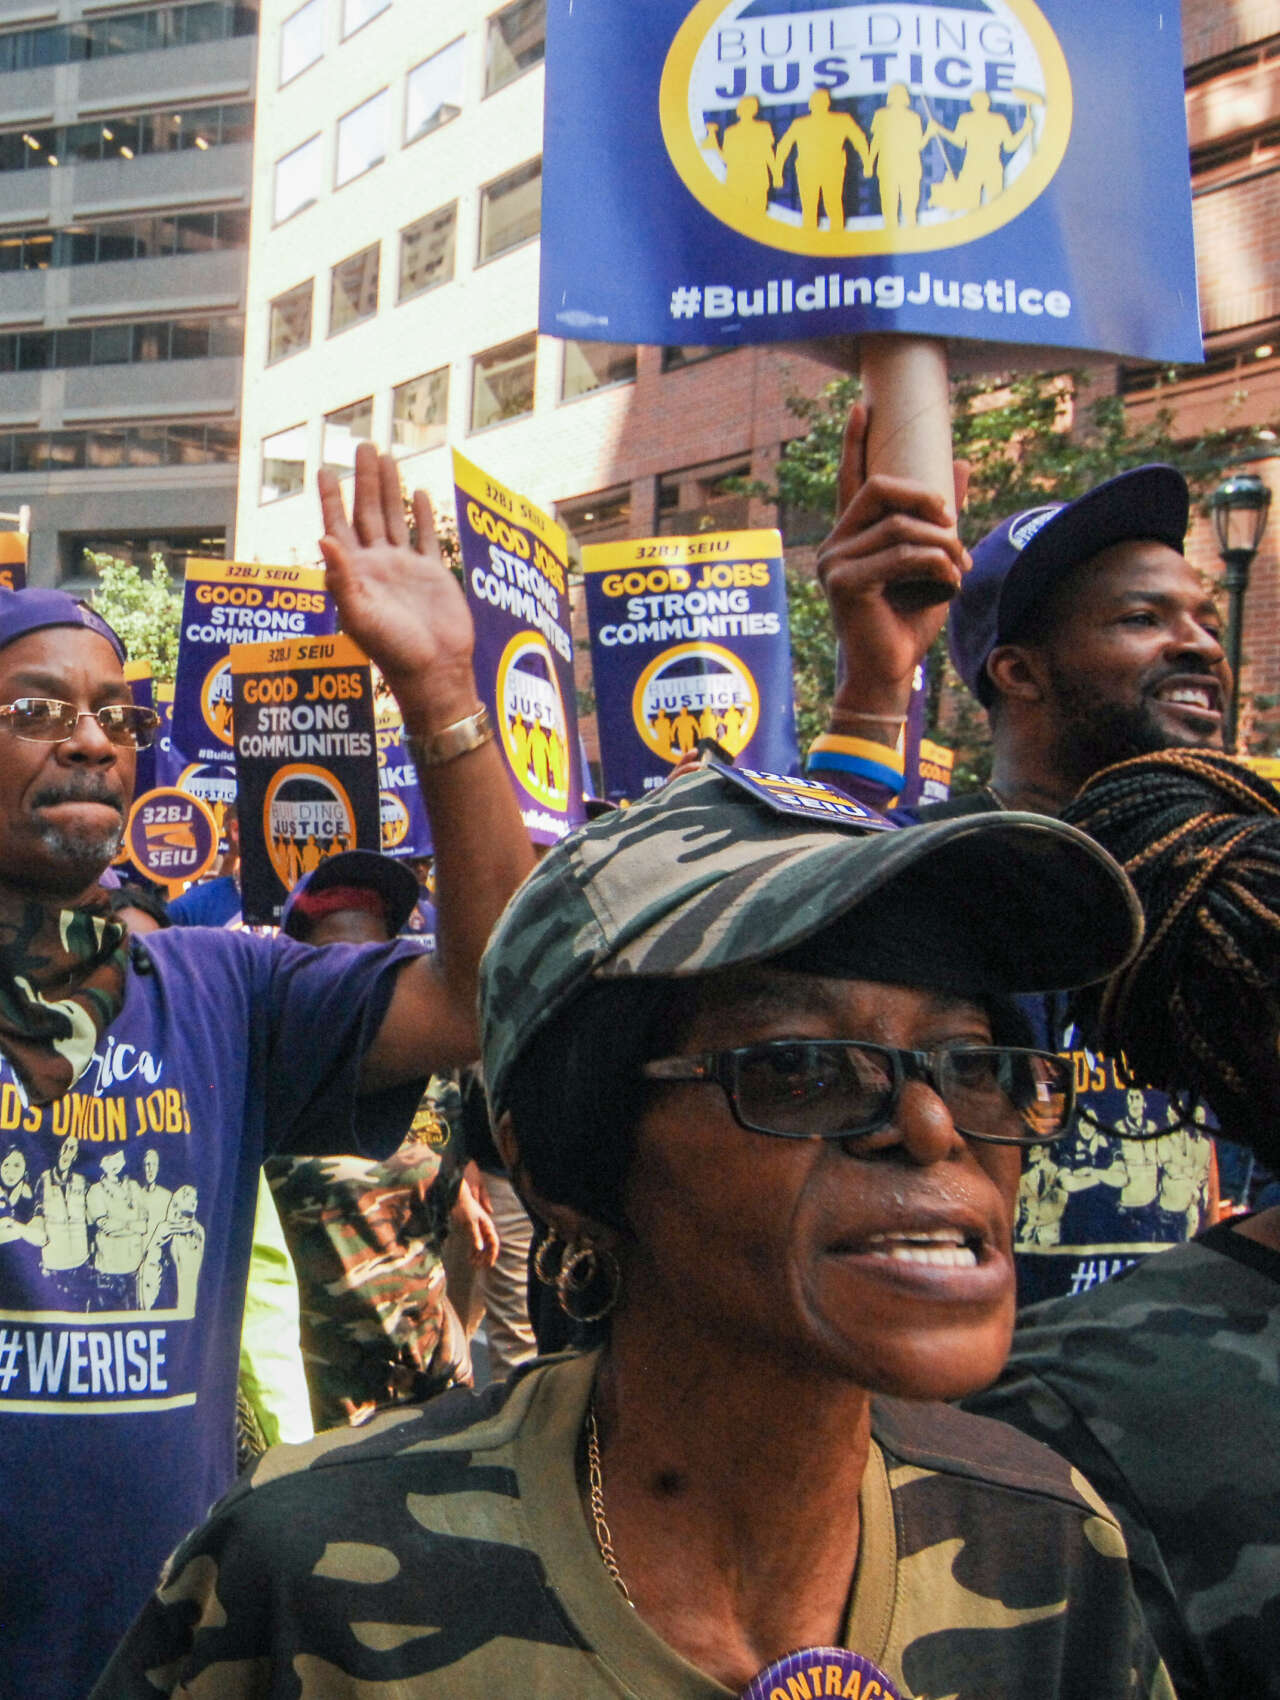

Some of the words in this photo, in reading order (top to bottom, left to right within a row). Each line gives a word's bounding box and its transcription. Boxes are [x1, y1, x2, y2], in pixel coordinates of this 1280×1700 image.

[715, 13, 1016, 64] BUILDING
[715, 53, 1017, 99] JUSTICE
[670, 271, 1071, 320] #BuildingJustice
[466, 501, 532, 560] GOOD
[533, 540, 565, 596] JOBS
[635, 545, 679, 560] 32BJ
[687, 540, 730, 555] SEIU
[225, 565, 260, 579] 32BJ
[265, 569, 300, 582] SEIU
[488, 543, 560, 620] STRONG
[601, 567, 692, 598] GOOD
[696, 562, 771, 590] JOBS
[195, 584, 263, 607] GOOD
[266, 590, 326, 614] JOBS
[626, 588, 750, 621] STRONG
[210, 606, 306, 632] STRONG
[471, 567, 573, 663] COMMUNITIES
[598, 612, 782, 647] COMMUNITIES
[297, 644, 335, 660] SEIU
[243, 676, 298, 704] GOOD
[304, 673, 363, 700] JOBS
[650, 692, 741, 711] JUSTICE
[257, 703, 349, 732] STRONG
[238, 733, 372, 758] COMMUNITIES
[378, 763, 419, 790] IKE
[738, 766, 827, 790] 32BJ
[188, 789, 233, 799] USTIC
[777, 792, 869, 818] SEIU
[142, 805, 194, 824] 32BJ
[271, 804, 344, 821] BUILDING
[274, 820, 344, 836] JUSTICE
[148, 849, 198, 867] SEIU
[51, 1090, 128, 1142] UNION
[770, 1664, 897, 1700] NTRAC
